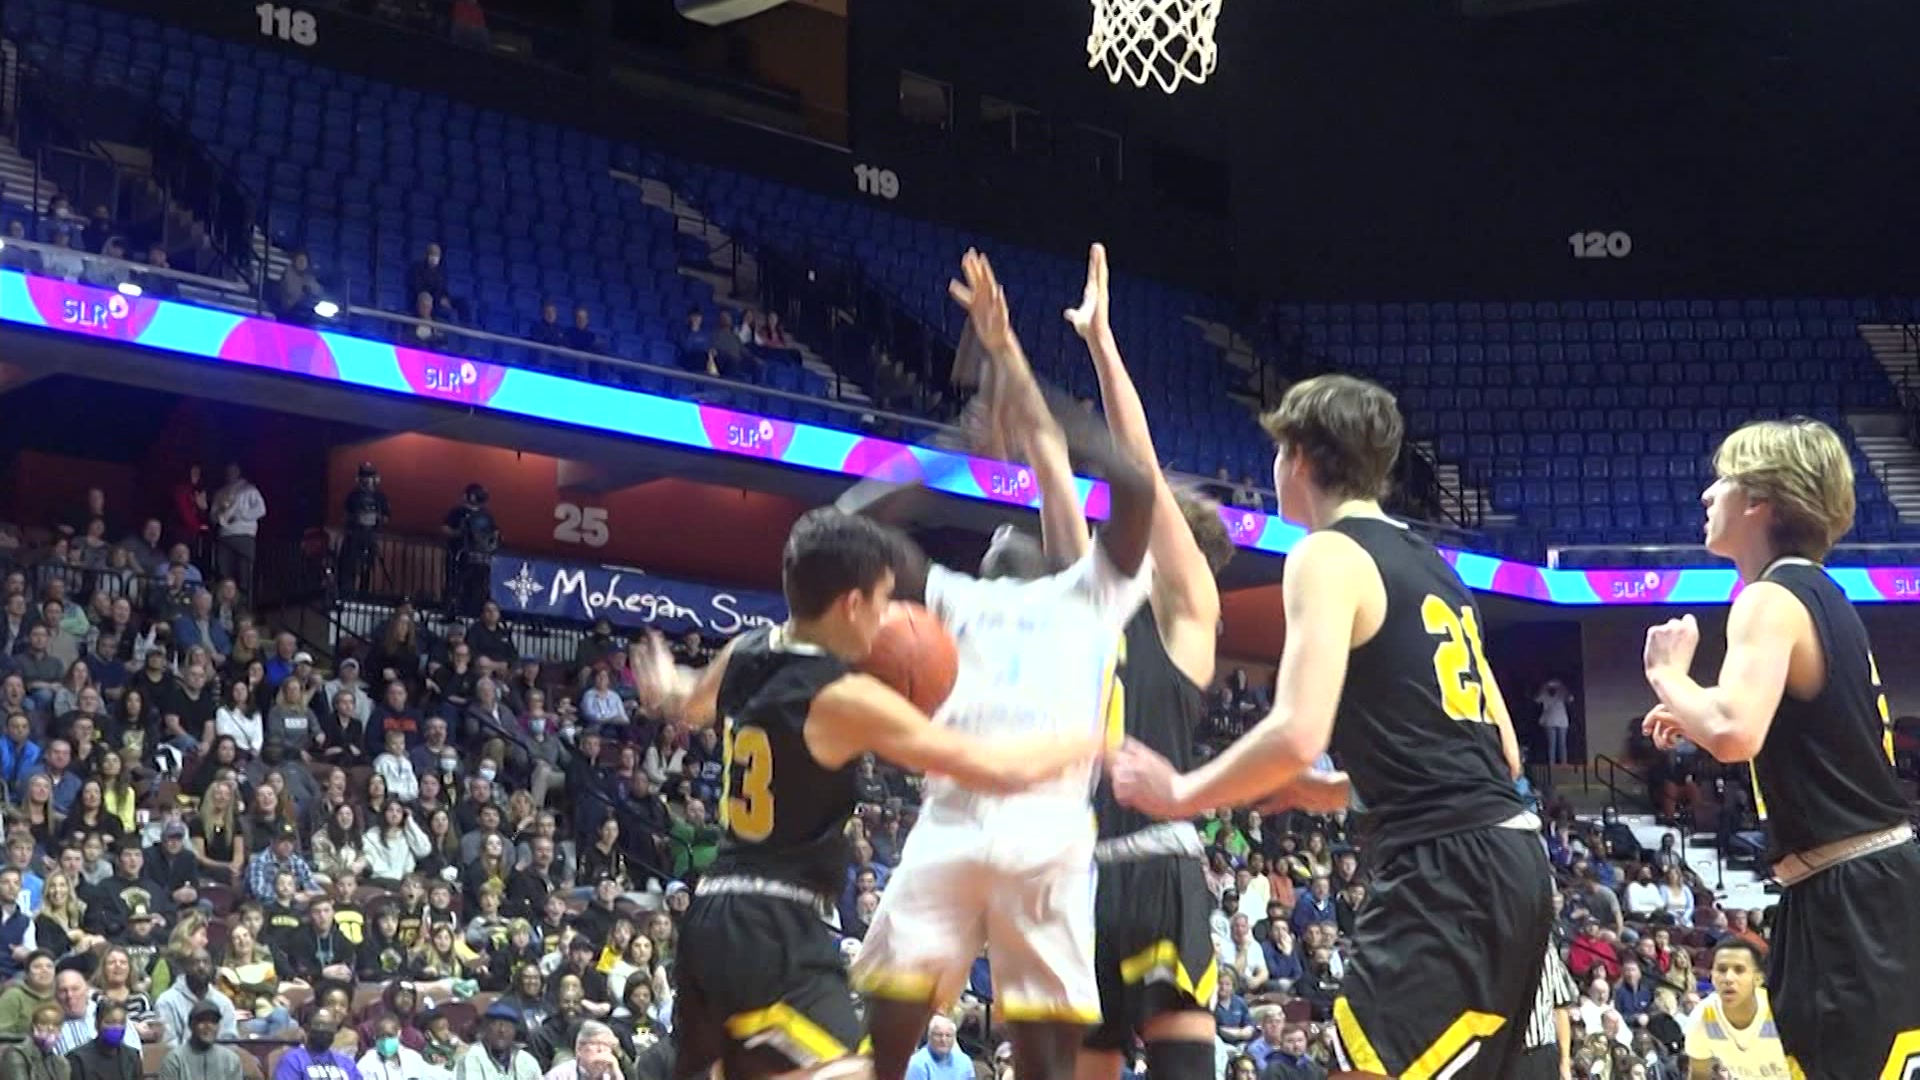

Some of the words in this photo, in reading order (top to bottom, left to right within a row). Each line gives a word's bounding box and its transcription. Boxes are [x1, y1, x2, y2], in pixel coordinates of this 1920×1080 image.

[256, 3, 318, 46] 118
[853, 164, 900, 199] 119
[1567, 231, 1632, 258] 120
[63, 299, 109, 329] SLR
[425, 368, 460, 393] SLR
[553, 502, 609, 547] 25
[549, 568, 703, 629] Mohegan
[710, 593, 775, 635] Sun
[1420, 593, 1495, 724] 21
